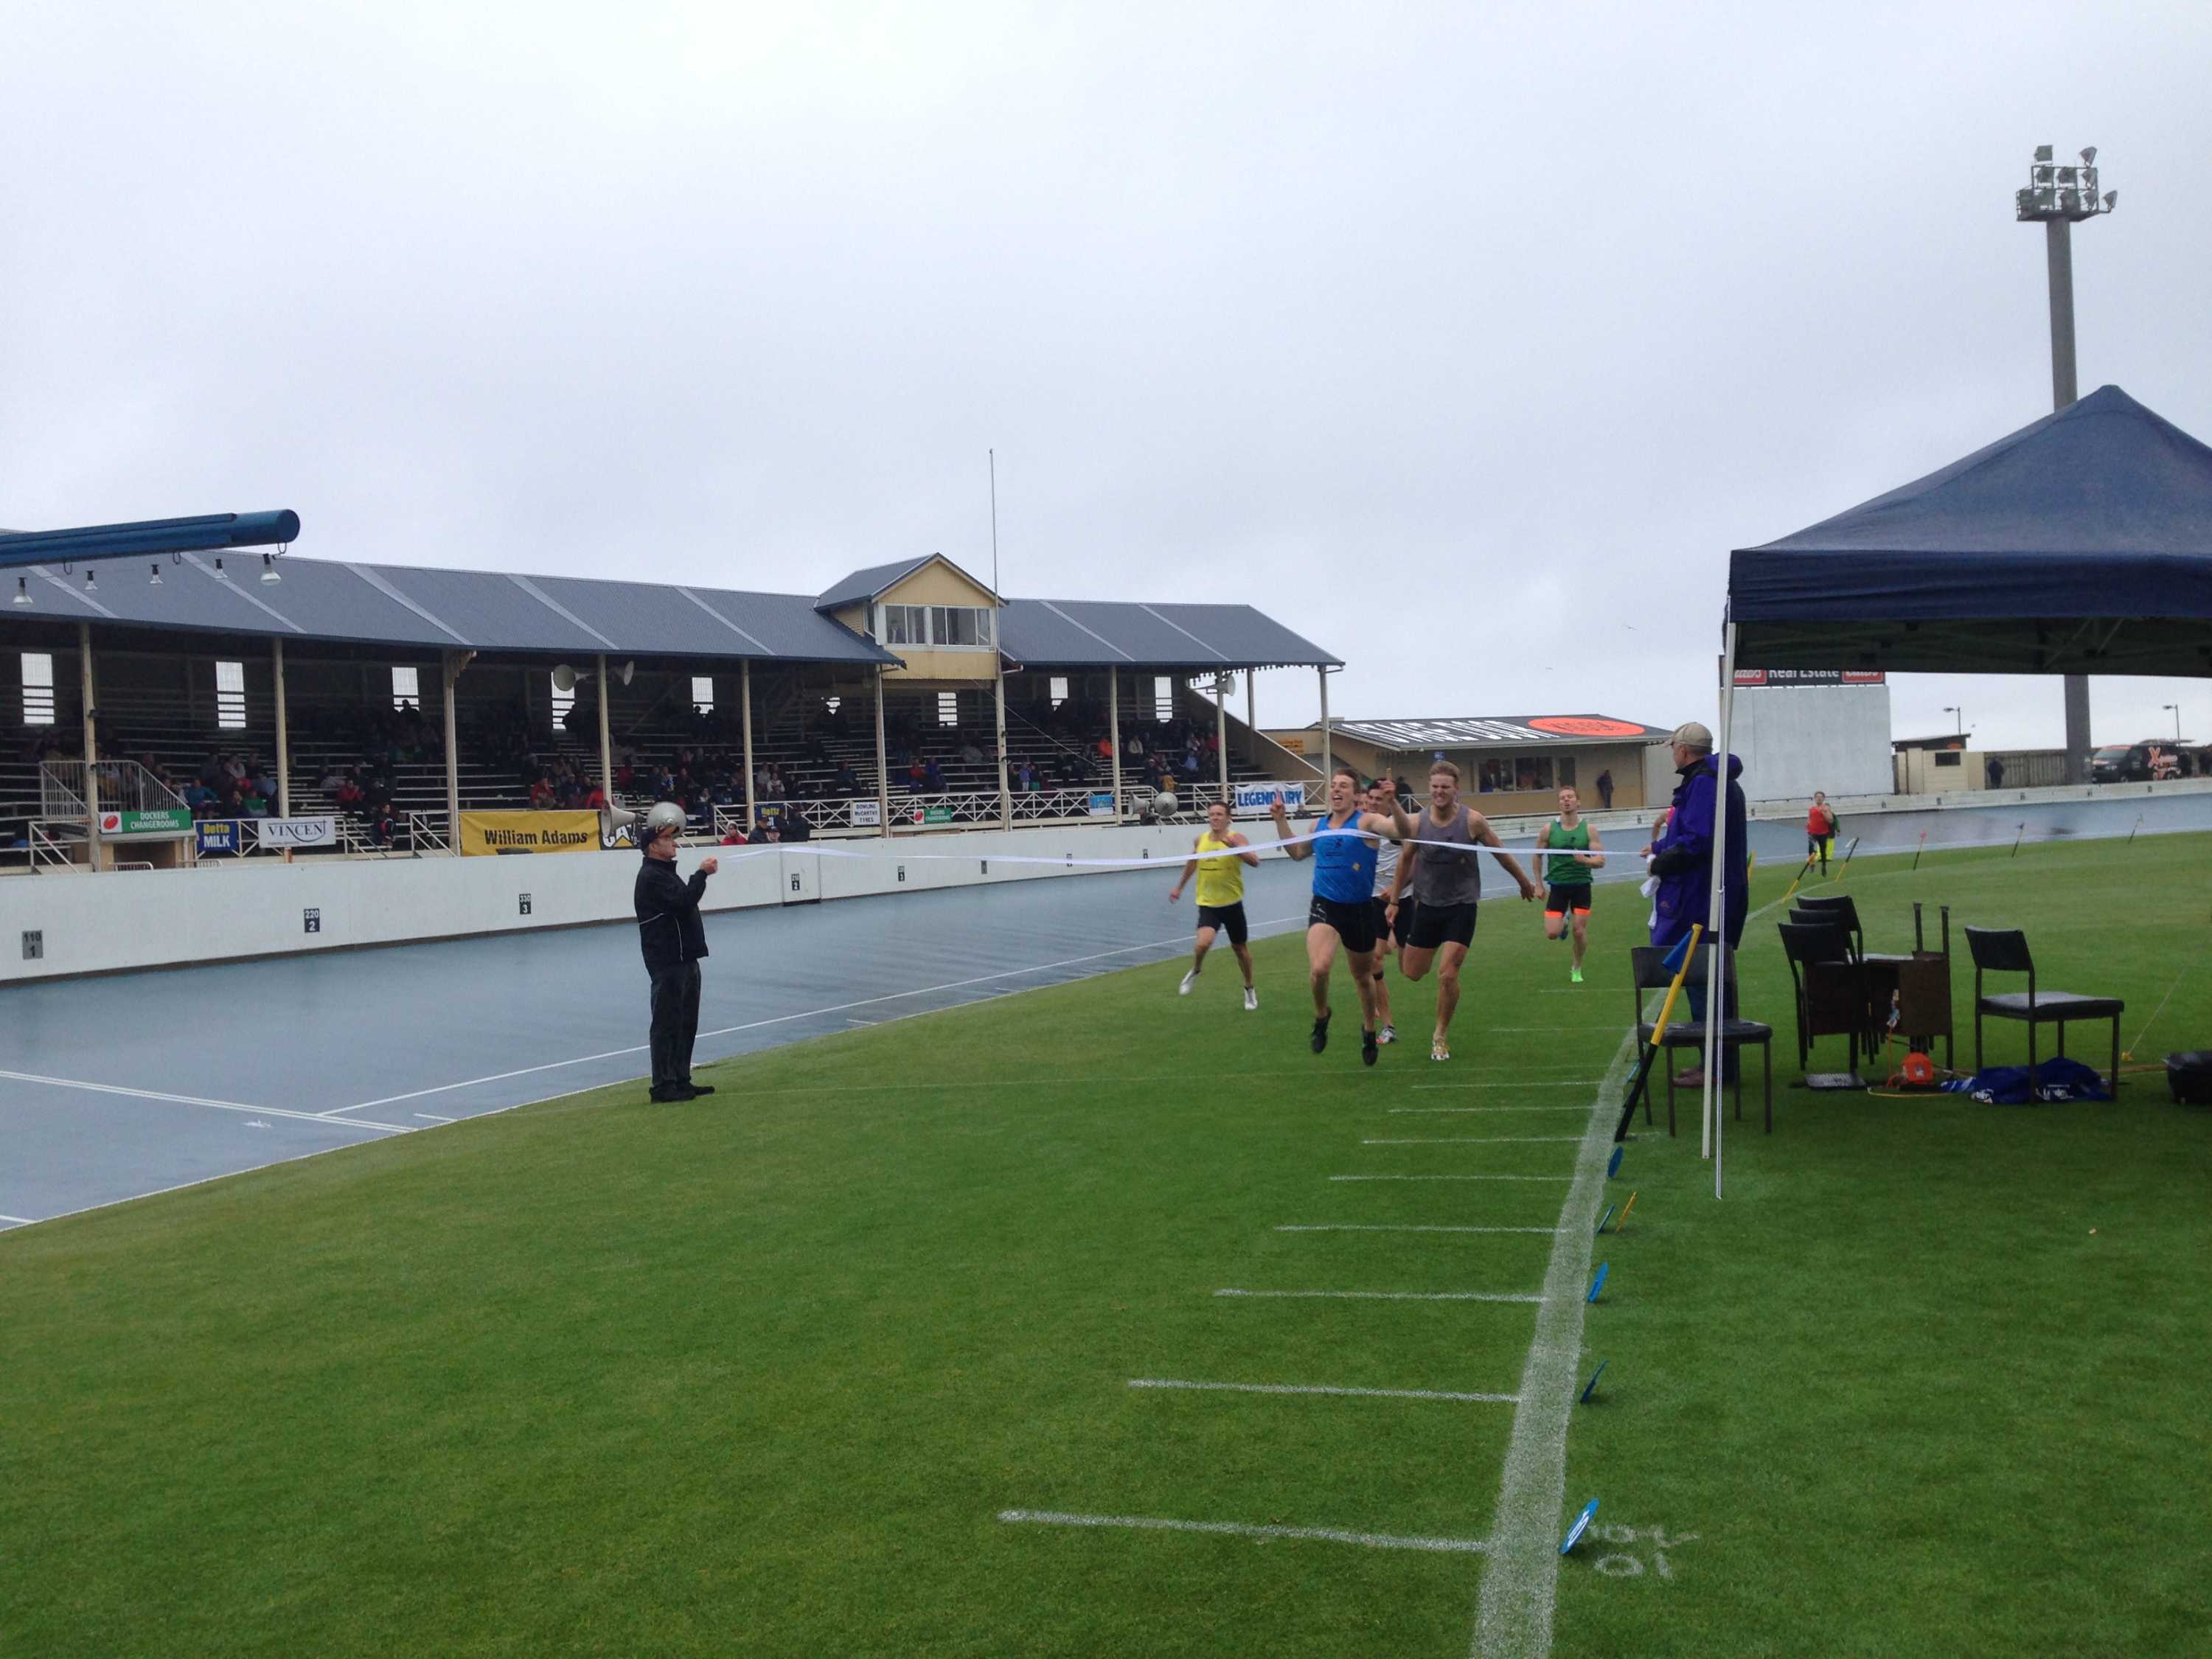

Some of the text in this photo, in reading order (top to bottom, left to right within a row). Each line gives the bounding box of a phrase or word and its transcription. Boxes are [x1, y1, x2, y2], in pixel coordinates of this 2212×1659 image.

[140, 812, 169, 821] DOCKERS
[130, 819, 179, 830] CHANGEROOMS
[204, 823, 230, 835] Betta
[204, 835, 230, 848] MILK
[484, 830, 588, 846] William Adams
[305, 909, 319, 919] 220
[523, 904, 528, 914] 3
[308, 921, 316, 931] 2
[23, 931, 42, 942] 110
[29, 945, 35, 958] 1
